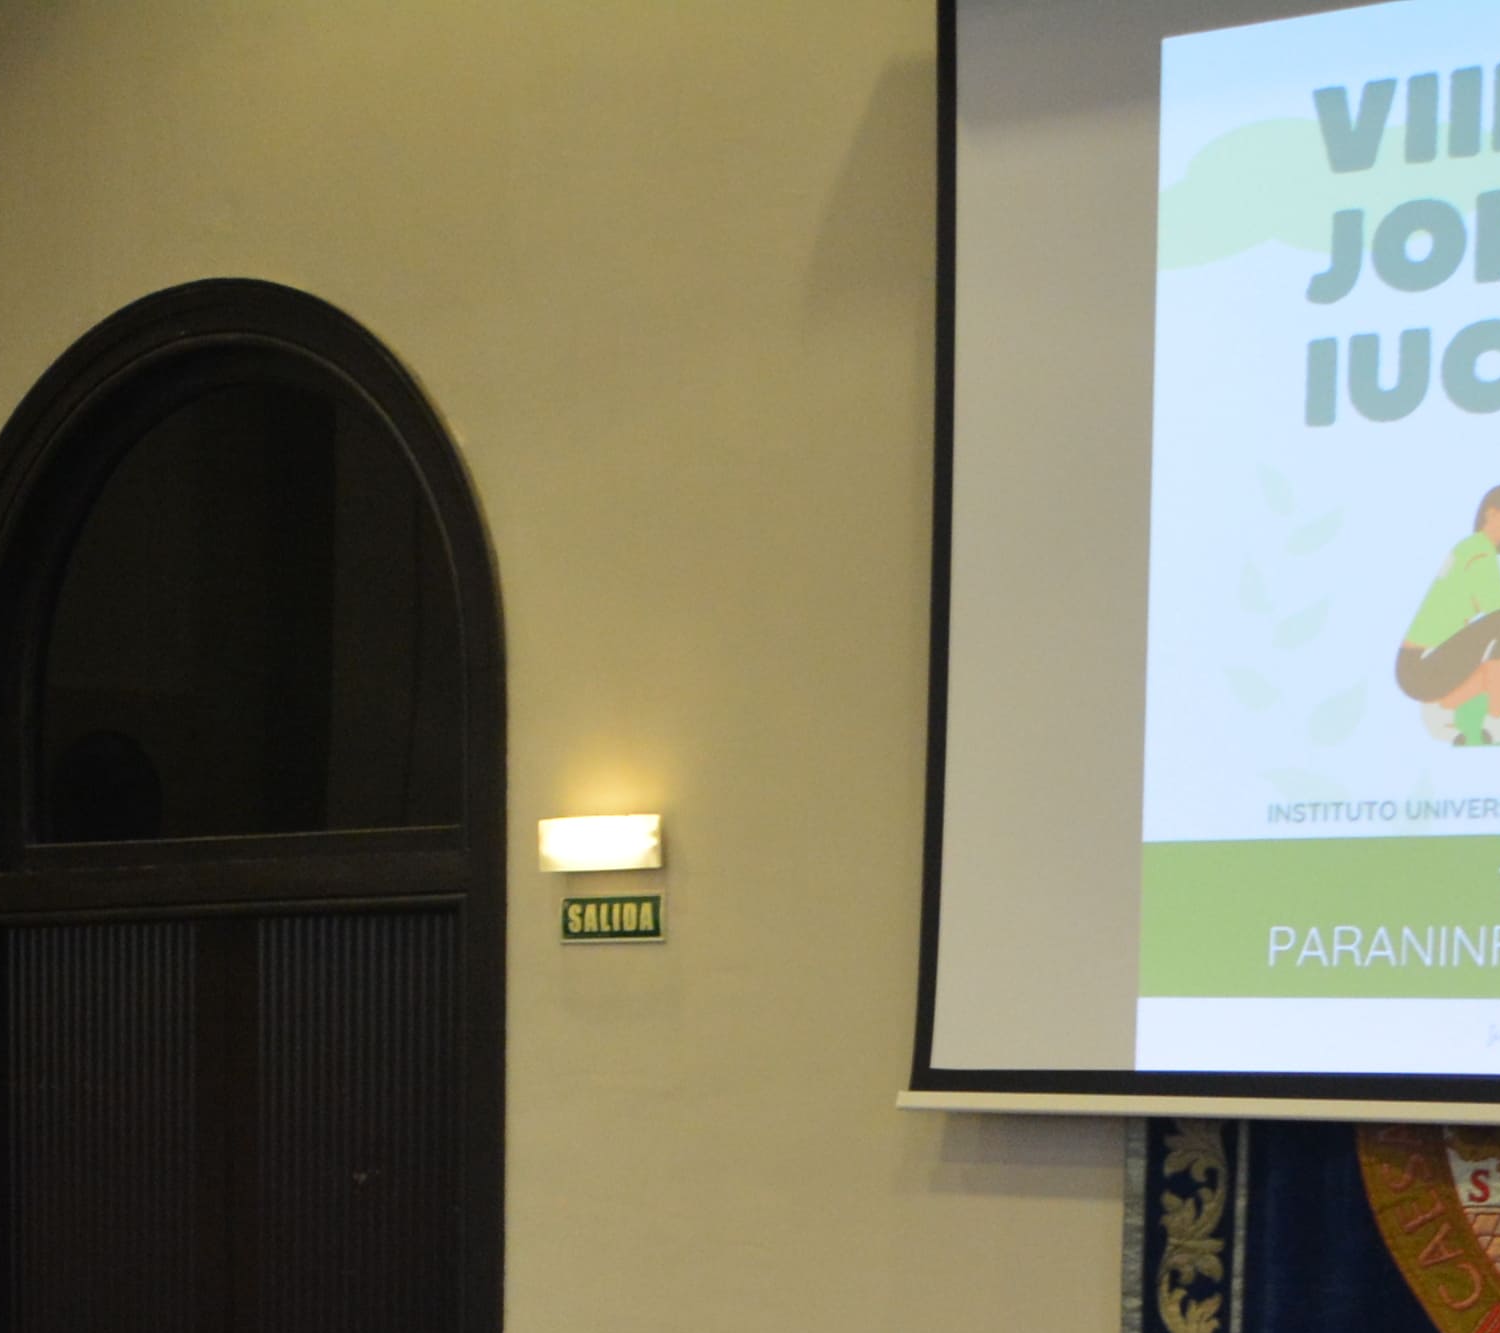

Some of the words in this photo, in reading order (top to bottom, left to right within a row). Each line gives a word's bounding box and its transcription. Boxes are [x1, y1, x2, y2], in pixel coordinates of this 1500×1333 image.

[1267, 797, 1398, 824] INSTITUTO
[568, 901, 654, 934] SALIDA
[1469, 1169, 1491, 1203] S
